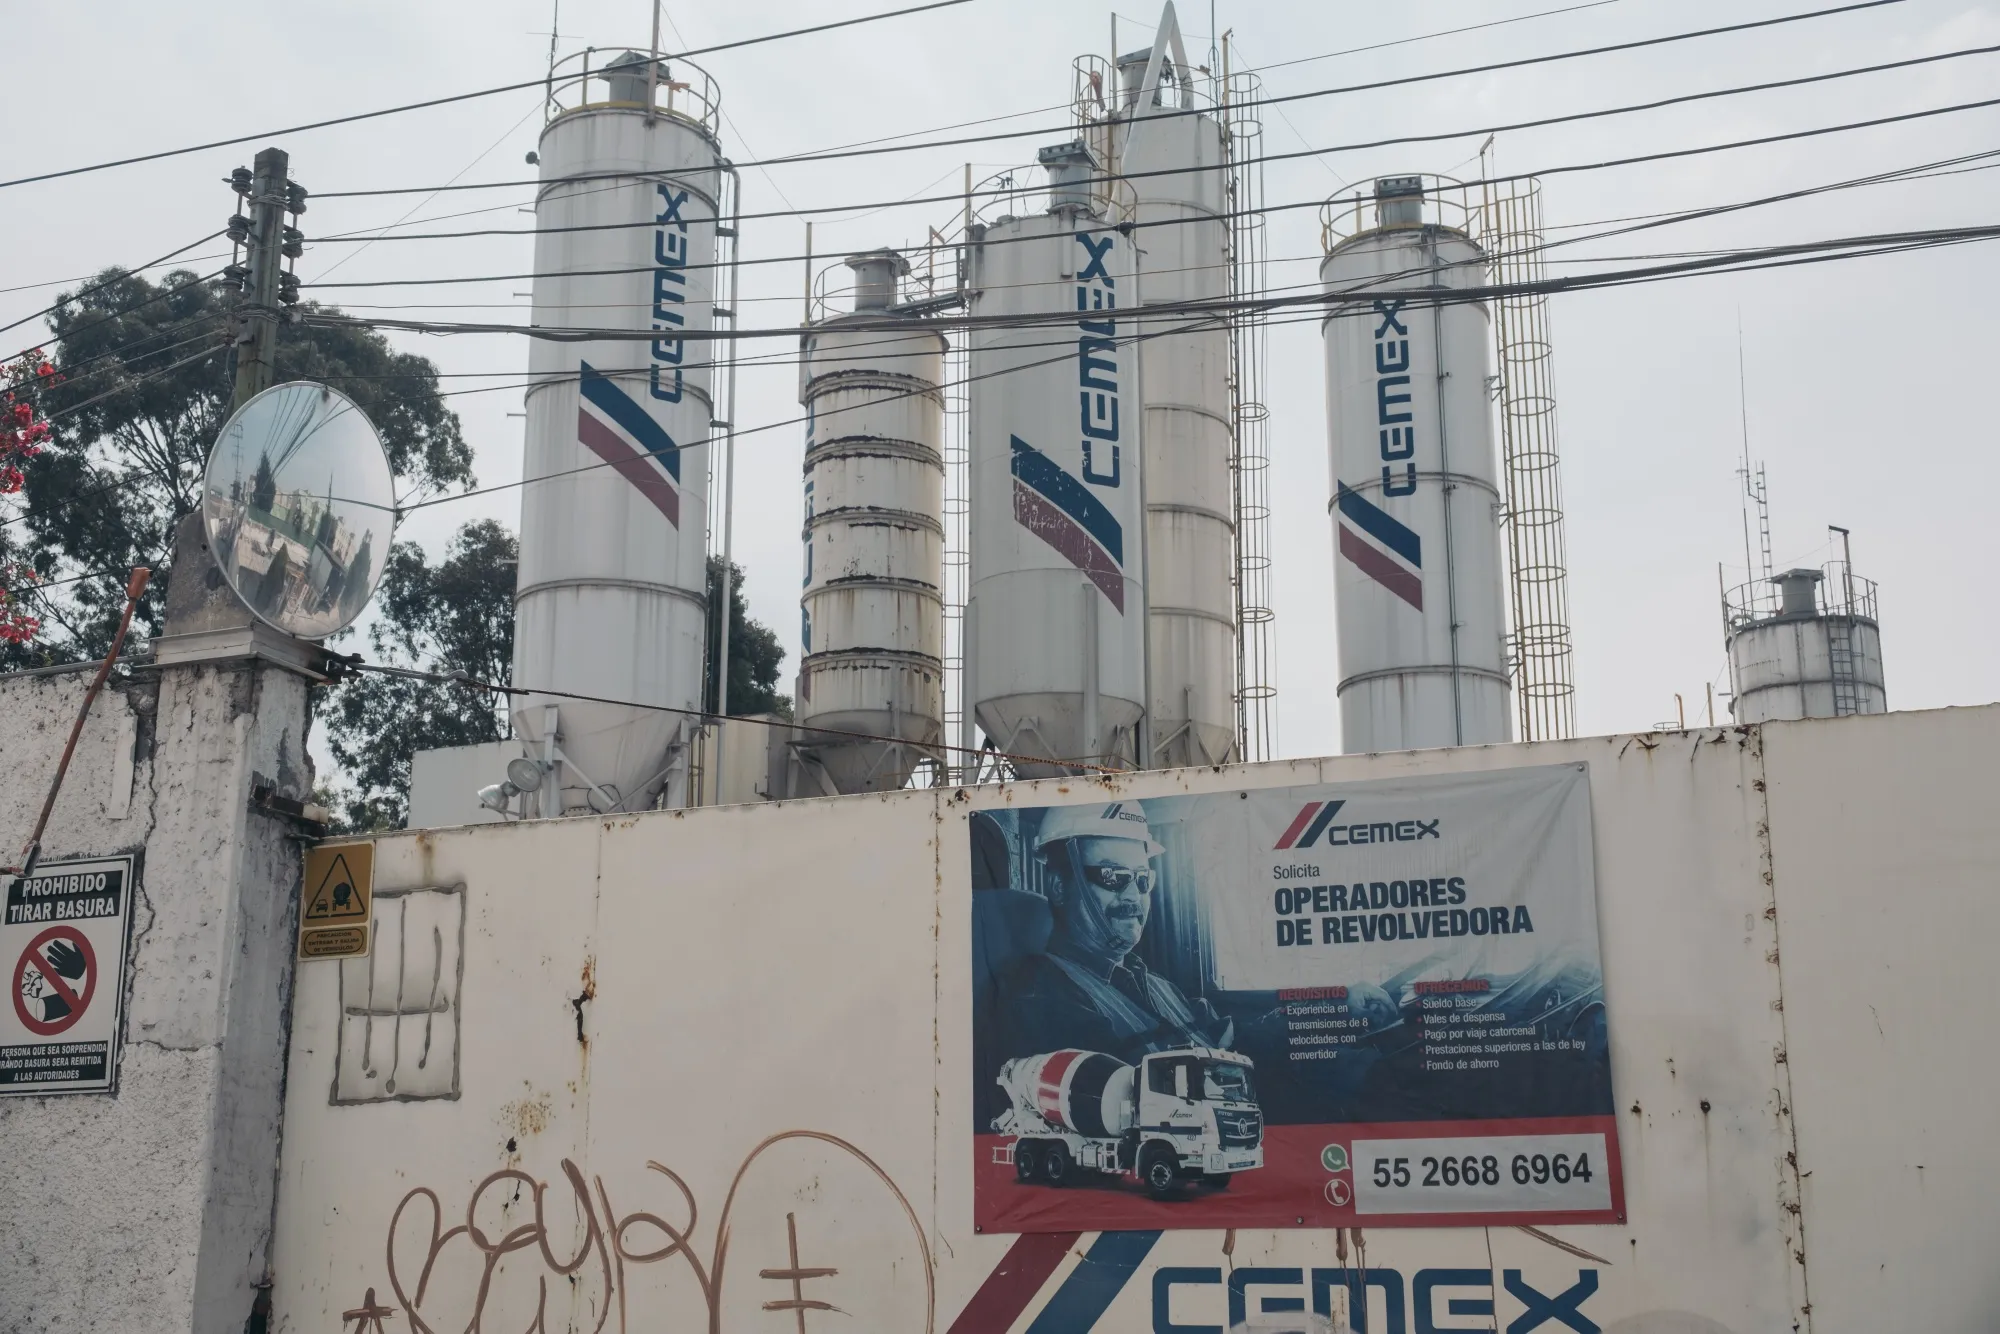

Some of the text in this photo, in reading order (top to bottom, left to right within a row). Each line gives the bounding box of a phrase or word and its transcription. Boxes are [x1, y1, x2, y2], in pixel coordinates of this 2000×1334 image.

[650, 183, 688, 404] CEMEX
[1076, 232, 1120, 488] CEMEX
[1374, 297, 1416, 497] CEMEX
[1328, 818, 1440, 846] CEMEX
[1273, 864, 1320, 880] Solicita
[22, 873, 107, 898] PROHIBIDO
[1274, 876, 1466, 916] OPERADORES
[10, 897, 114, 922] TIRAR BASURA
[1276, 905, 1534, 946] DE REVOLVEDORA
[1414, 980, 1489, 994] OFRECEMOS
[1286, 1004, 1336, 1016] Experiencia
[1422, 998, 1476, 1009] Sueldo base
[1288, 1017, 1368, 1030] transmisiones de 8
[1423, 1012, 1506, 1025] Vales de despensa
[1288, 1035, 1356, 1045] velocidades con
[1425, 1025, 1536, 1041] Pago por viaje catorcenal
[2, 1044, 106, 1057] PERSONA QUE SEA SORPRENDIDA
[1425, 1044, 1482, 1055] Prestaciones
[1484, 1042, 1531, 1055] superiores
[1542, 1040, 1556, 1050] las
[1558, 1040, 1570, 1049] de
[1572, 1038, 1586, 1051] ley
[0, 1056, 101, 1069] RANDO BASURA SERA REMITIDA
[1290, 1050, 1338, 1060] convertidor
[1426, 1058, 1499, 1070] Fondo de ahorro
[14, 1070, 80, 1082] A LAS AUTORIDADES
[1373, 1152, 1592, 1188] 55 2668 6964
[1152, 1267, 1602, 1334] CEMEX
